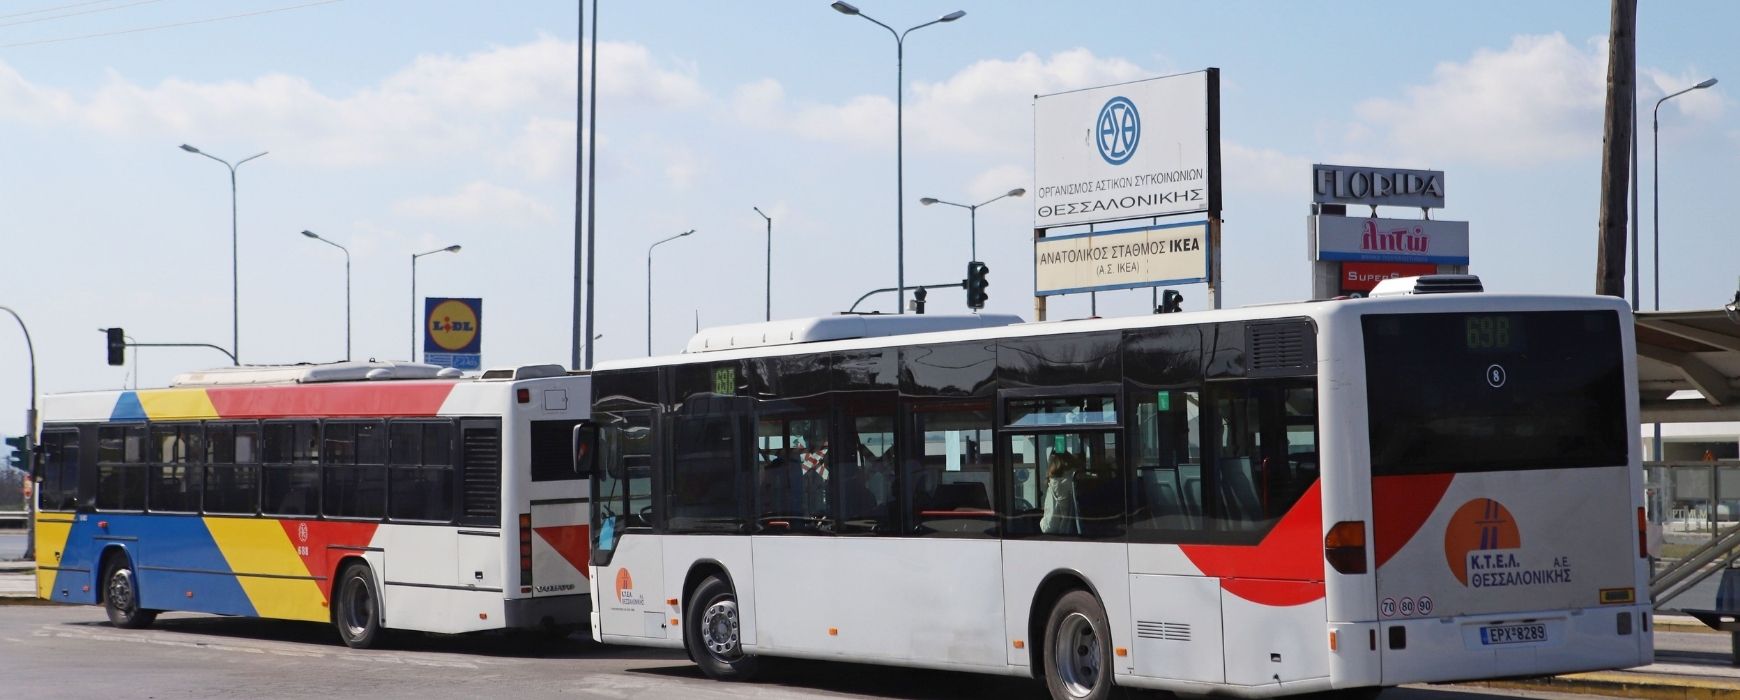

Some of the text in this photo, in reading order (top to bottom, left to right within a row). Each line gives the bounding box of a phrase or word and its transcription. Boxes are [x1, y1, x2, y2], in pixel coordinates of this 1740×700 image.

[1038, 168, 1203, 199] ΟΡΓΑΝΙΣΜΟΣ ΑΣΤΙΚΩΝ ΣΥΓΚΟΙΝΩΝΙΩΝ
[1316, 169, 1444, 199] FLORIDA
[1038, 188, 1203, 218] ΘΕΣΣΑΛΟΝΙΚΗΣ
[1039, 246, 1108, 265] ΑΝΑΤΟΛΙΚΟΣ
[1111, 241, 1166, 259] ΣΤΑΘΜΟΣ
[1471, 553, 1520, 569] Κ.Τ.Ε.Λ.
[1472, 568, 1572, 588] ΘΕΣΣΑΛΟΝΙΚΗΣ
[1383, 600, 1431, 612] 70 80 90
